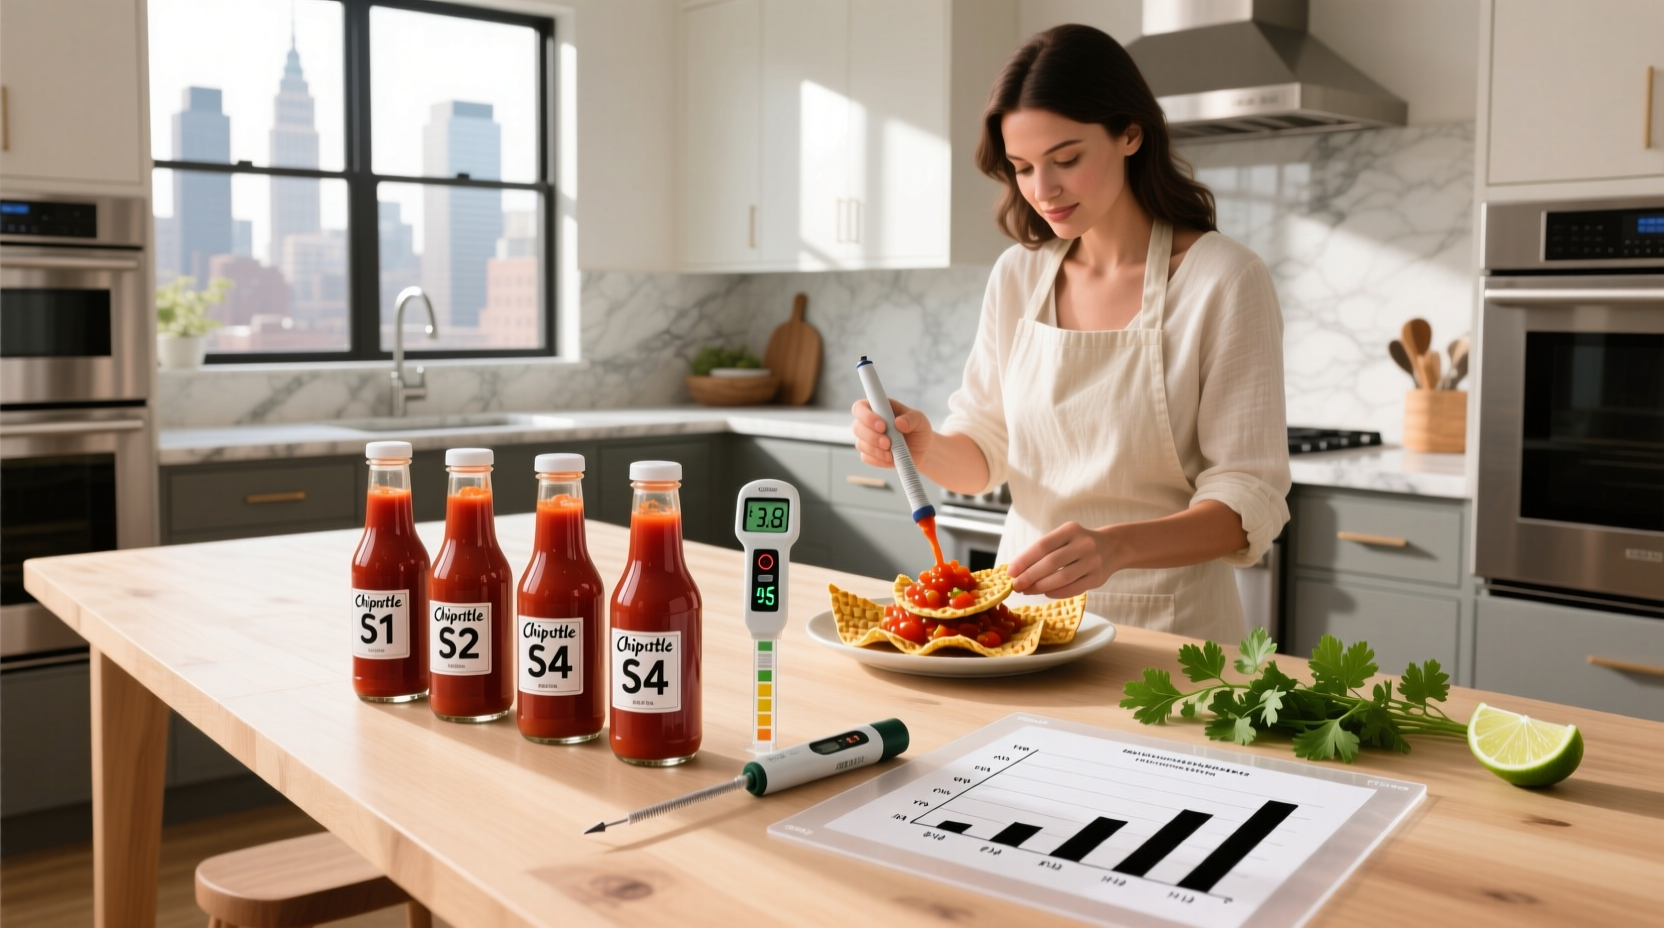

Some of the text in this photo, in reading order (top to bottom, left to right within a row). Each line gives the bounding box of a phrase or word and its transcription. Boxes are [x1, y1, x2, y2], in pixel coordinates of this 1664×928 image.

[360, 613, 393, 644] S1
[438, 626, 479, 659] S2
[528, 644, 572, 679] S4
[622, 658, 669, 695] S4
